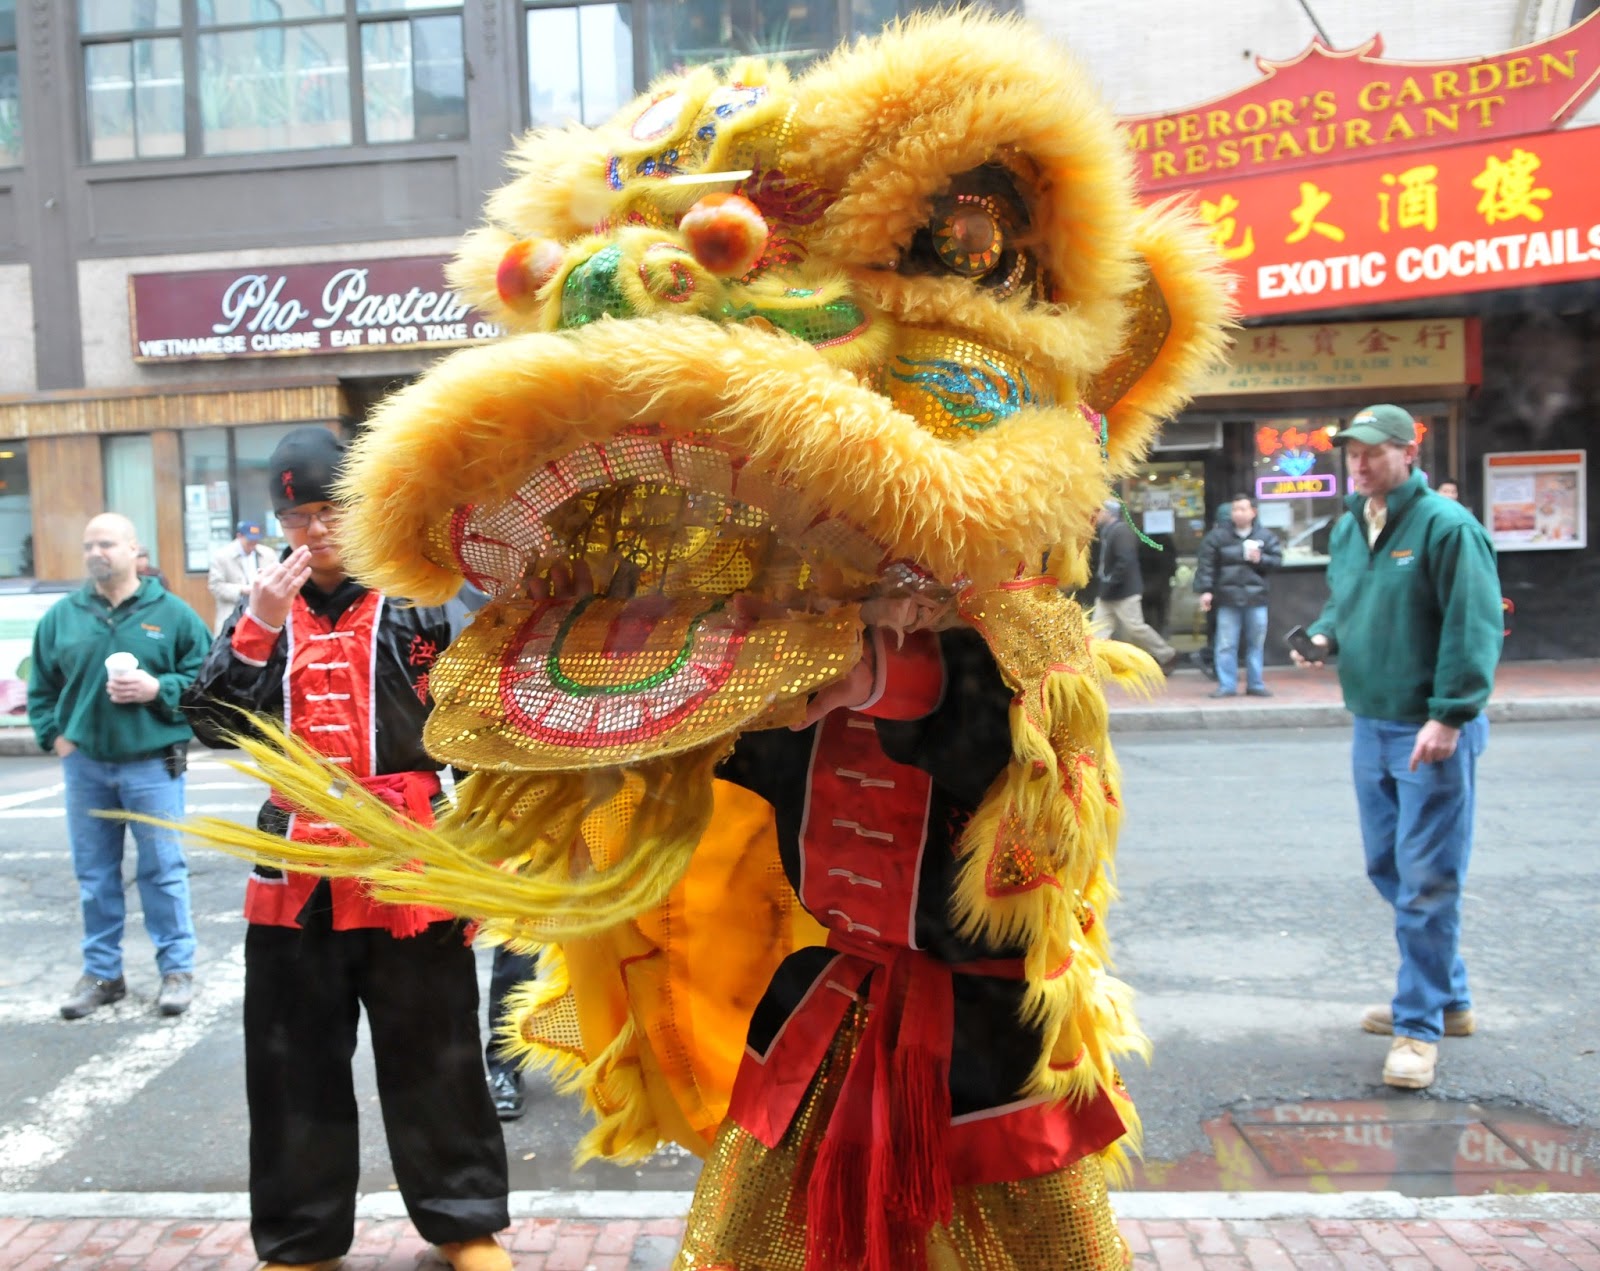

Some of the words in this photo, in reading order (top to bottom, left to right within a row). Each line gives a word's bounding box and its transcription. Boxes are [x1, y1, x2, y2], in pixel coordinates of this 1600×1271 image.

[1125, 91, 1337, 151] MPEROR'S
[1358, 49, 1579, 112] GARDEN
[1151, 96, 1505, 180] RESTAURANT
[1198, 148, 1553, 261] 苑大酒樓
[1257, 251, 1387, 299] EXOTIC
[1396, 224, 1600, 283] COCKTAILS
[139, 336, 247, 357] VIETNAMESE
[251, 332, 321, 351] CUISINE
[331, 328, 364, 347] EAT
[368, 326, 387, 344] IN
[396, 324, 418, 344] OR
[423, 322, 468, 341] TAKE
[472, 321, 508, 339] OU
[213, 274, 309, 335] Pho
[1252, 324, 1452, 358] 珠寶金行
